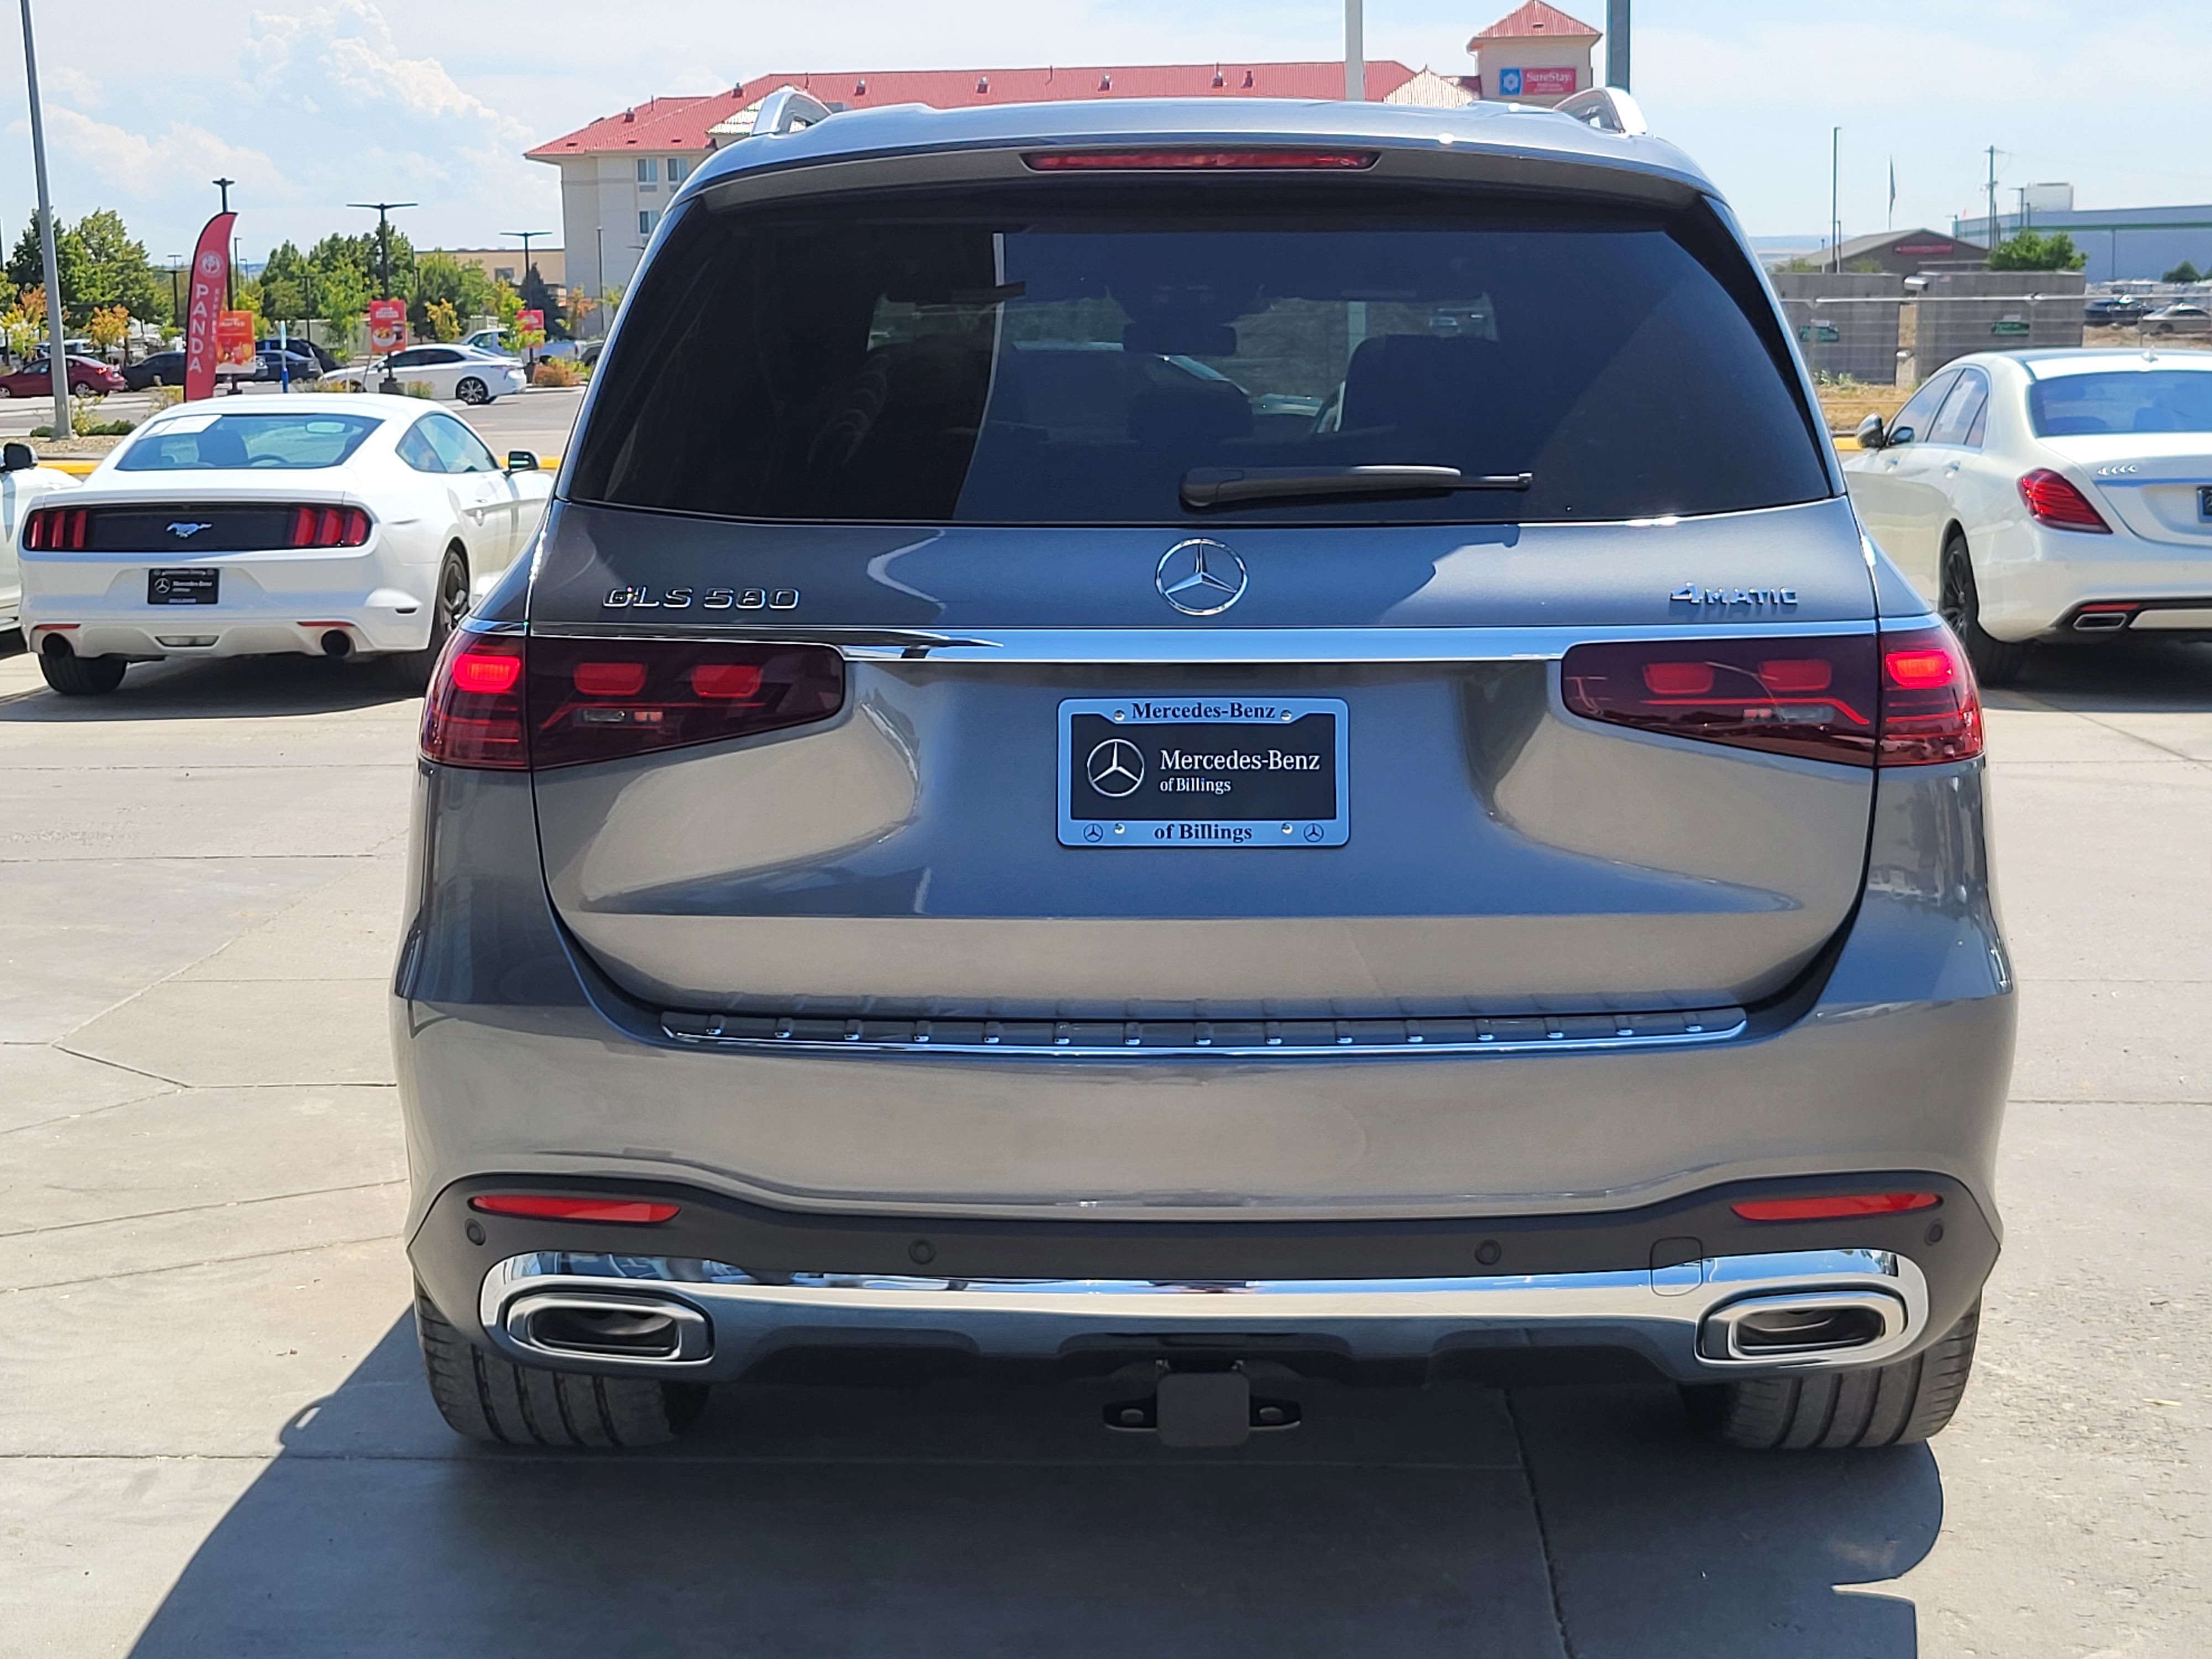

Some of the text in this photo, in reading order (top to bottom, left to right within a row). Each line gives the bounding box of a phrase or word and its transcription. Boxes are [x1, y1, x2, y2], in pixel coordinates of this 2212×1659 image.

[1527, 72, 1569, 83] SureStay
[189, 284, 209, 373] PANDA
[603, 586, 799, 609] GLS 580
[1670, 582, 1798, 604] 4MATIC
[1132, 703, 1275, 718] Mercedes-Benz
[1160, 750, 1320, 770] Mercedes-Benz
[1160, 778, 1231, 794] of Billings
[1155, 824, 1252, 842] of Billings
